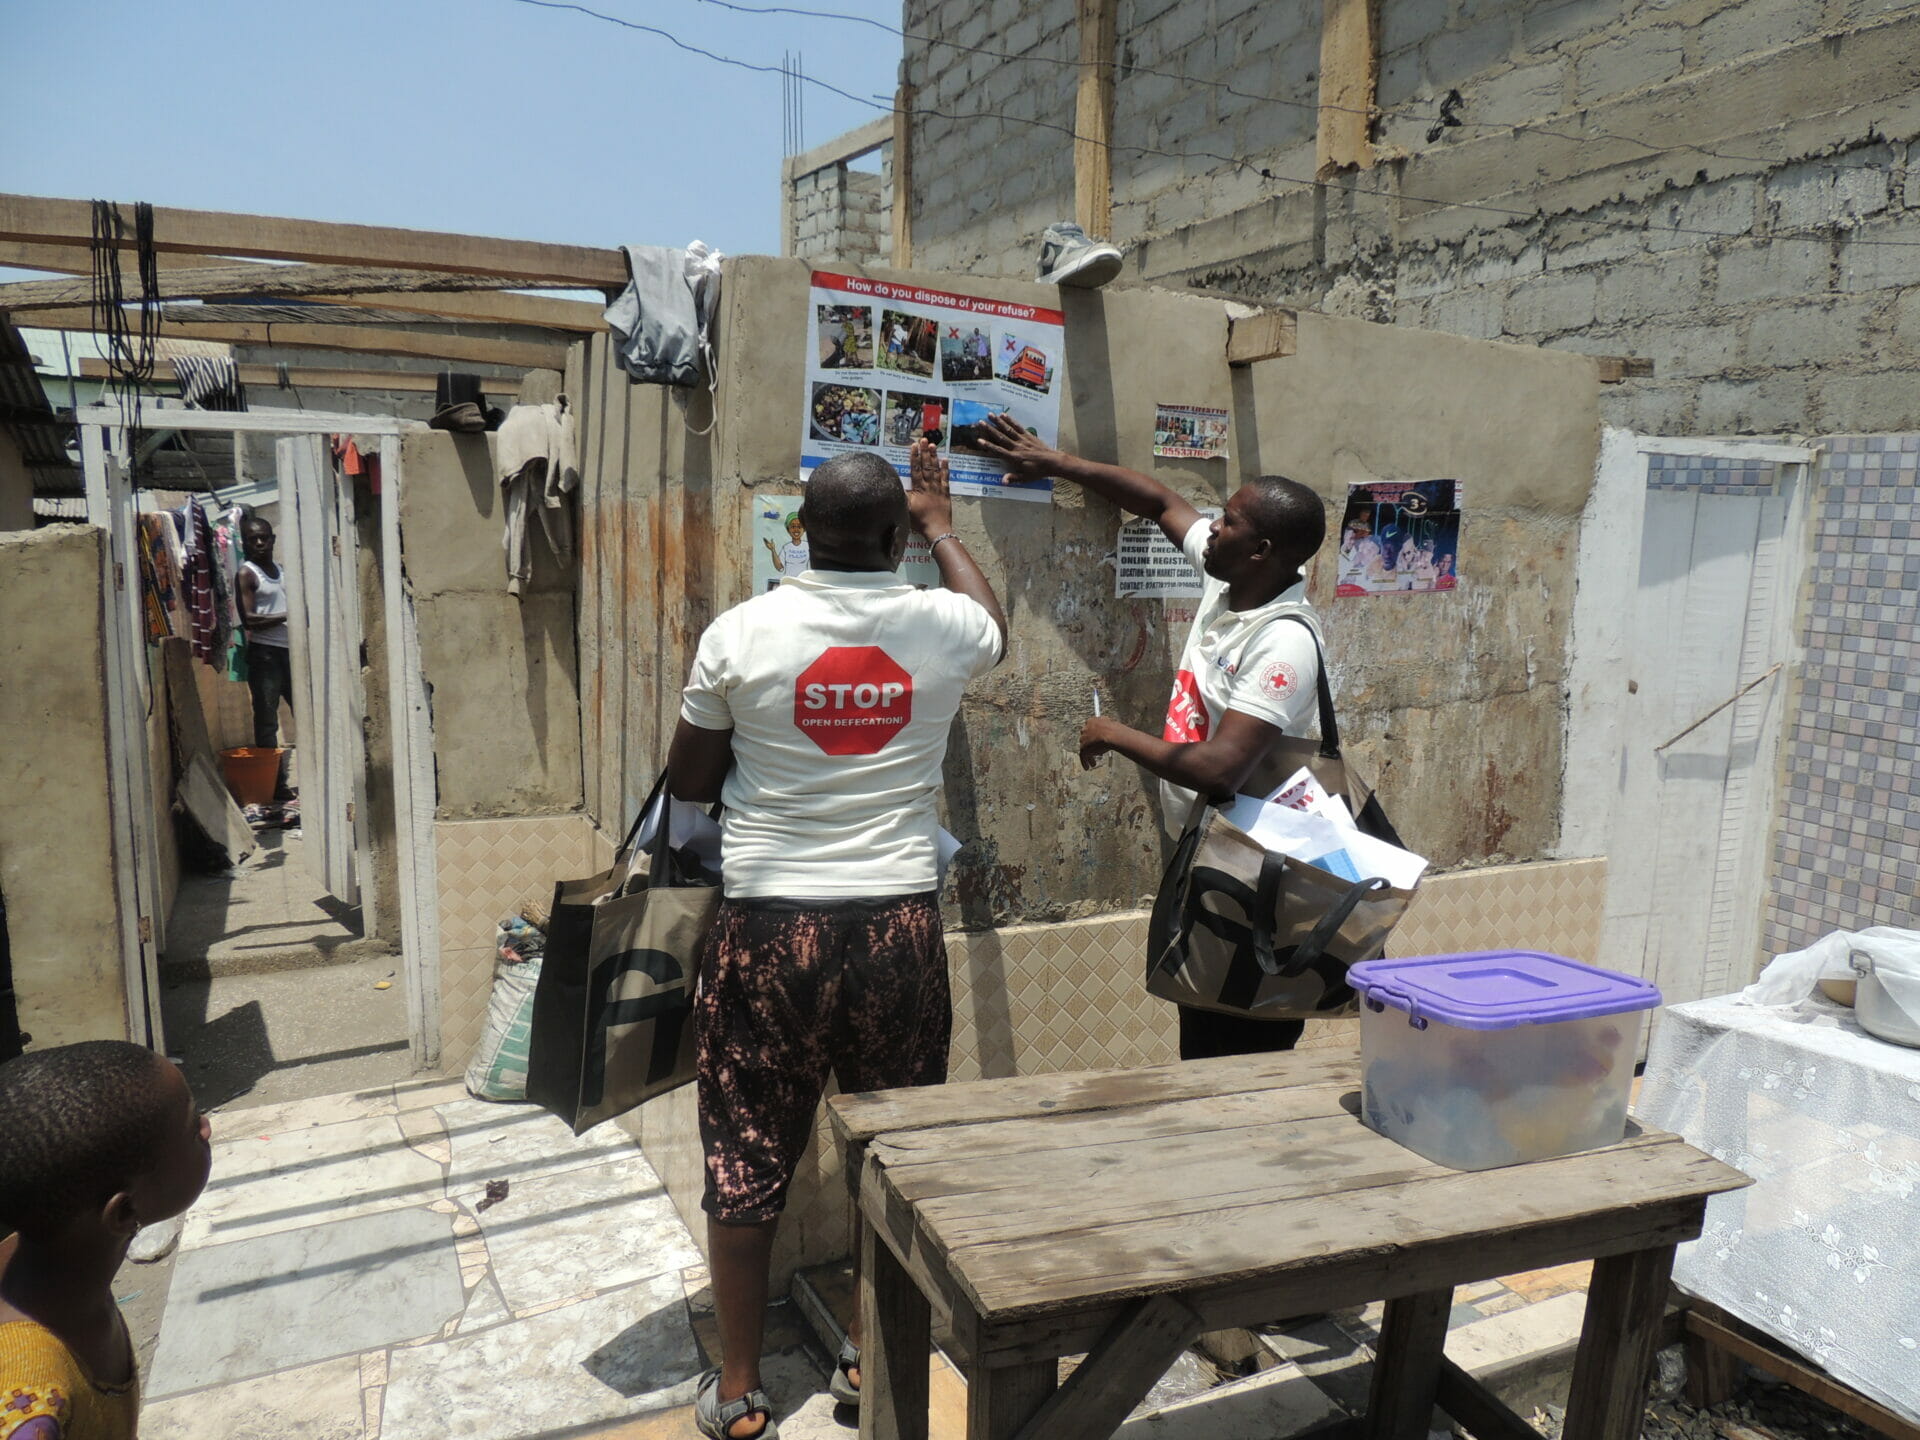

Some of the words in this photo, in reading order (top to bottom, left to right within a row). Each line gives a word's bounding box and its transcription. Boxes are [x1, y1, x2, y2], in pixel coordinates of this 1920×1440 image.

[846, 278, 872, 293] How
[875, 283, 889, 295] do
[891, 286, 912, 299] you
[914, 290, 956, 307] dispose
[958, 297, 970, 308] of
[971, 299, 995, 312] your
[997, 304, 1036, 318] refuse?
[1151, 546, 1180, 554] CHECK
[1121, 556, 1150, 565] ONLINE
[1153, 557, 1190, 565] REGISTR
[1157, 568, 1176, 577] MARKET
[803, 682, 905, 710] STOP
[802, 718, 831, 727] OPEN
[834, 716, 903, 727] DEFECATION!
